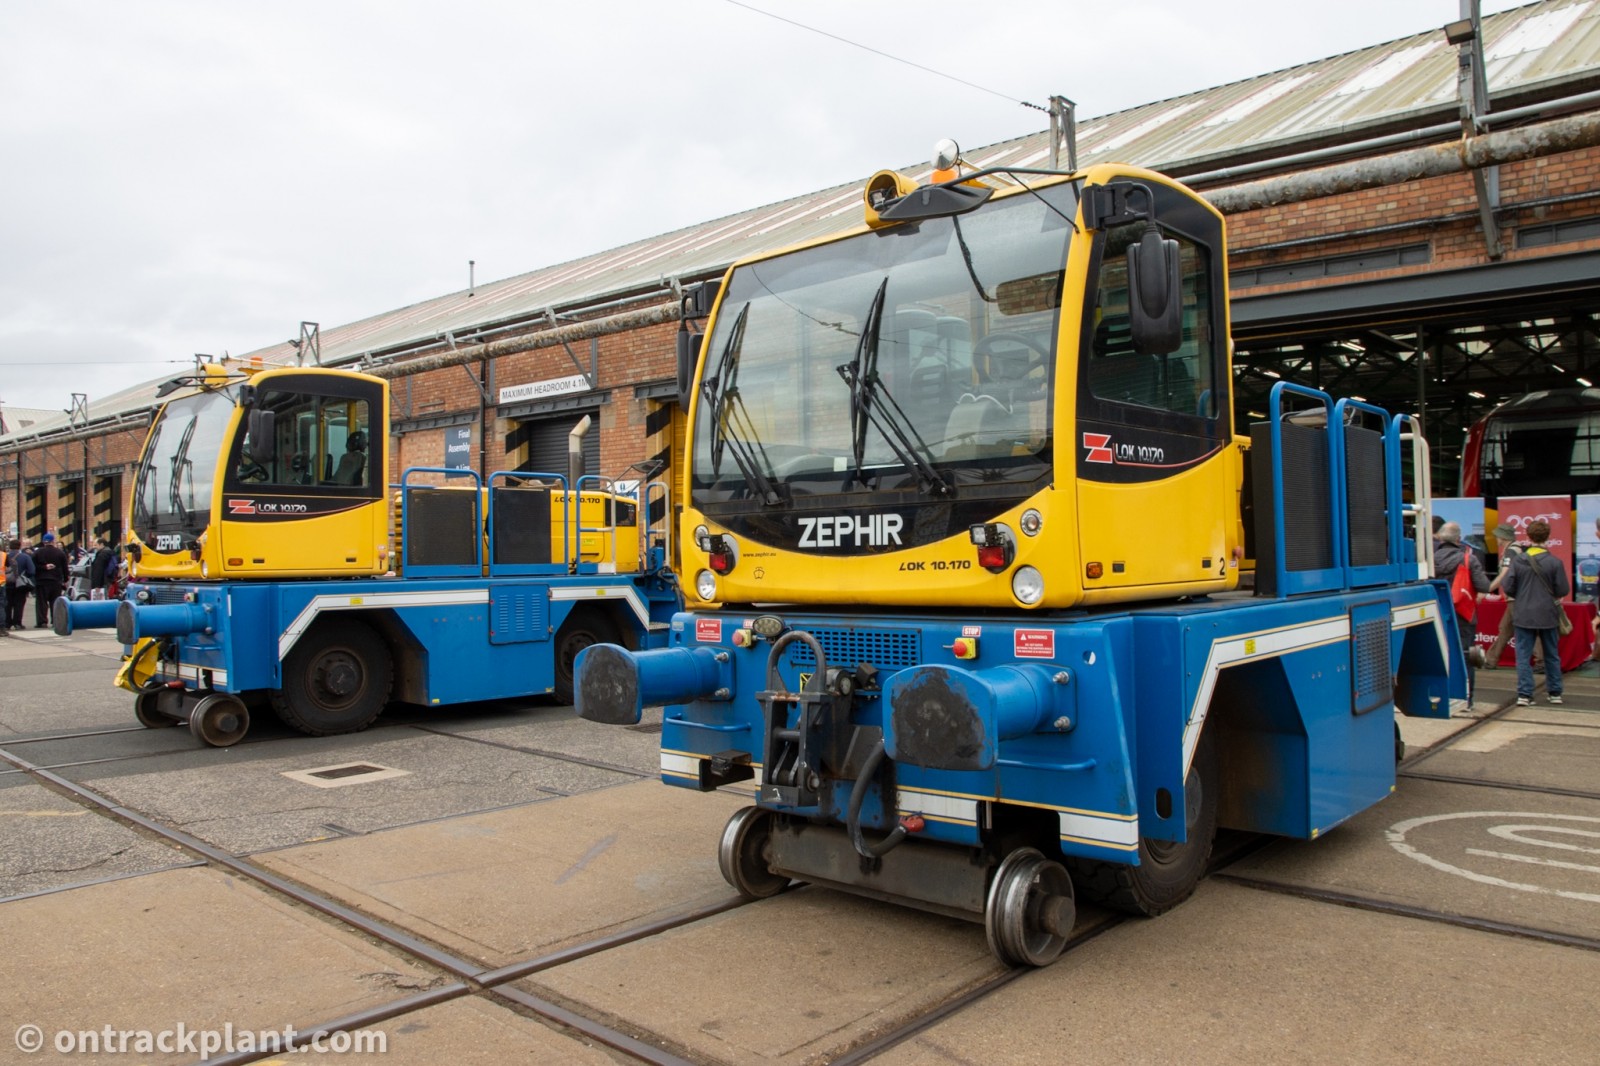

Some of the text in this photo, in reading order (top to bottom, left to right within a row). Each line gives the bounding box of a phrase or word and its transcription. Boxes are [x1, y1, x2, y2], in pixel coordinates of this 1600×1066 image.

[502, 387, 533, 400] MAXIMUM
[534, 380, 571, 395] HEADROOM
[458, 428, 471, 439] Final
[448, 442, 470, 453] Assembly
[1115, 443, 1136, 461] LOK
[575, 496, 600, 504] 0.170
[258, 504, 277, 512] LOK
[798, 513, 904, 548] ZEPHIR
[156, 534, 182, 551] ZEPHIR
[899, 560, 972, 572] LOK 10.170
[1219, 557, 1226, 576] 2
[963, 626, 980, 636] STOP
